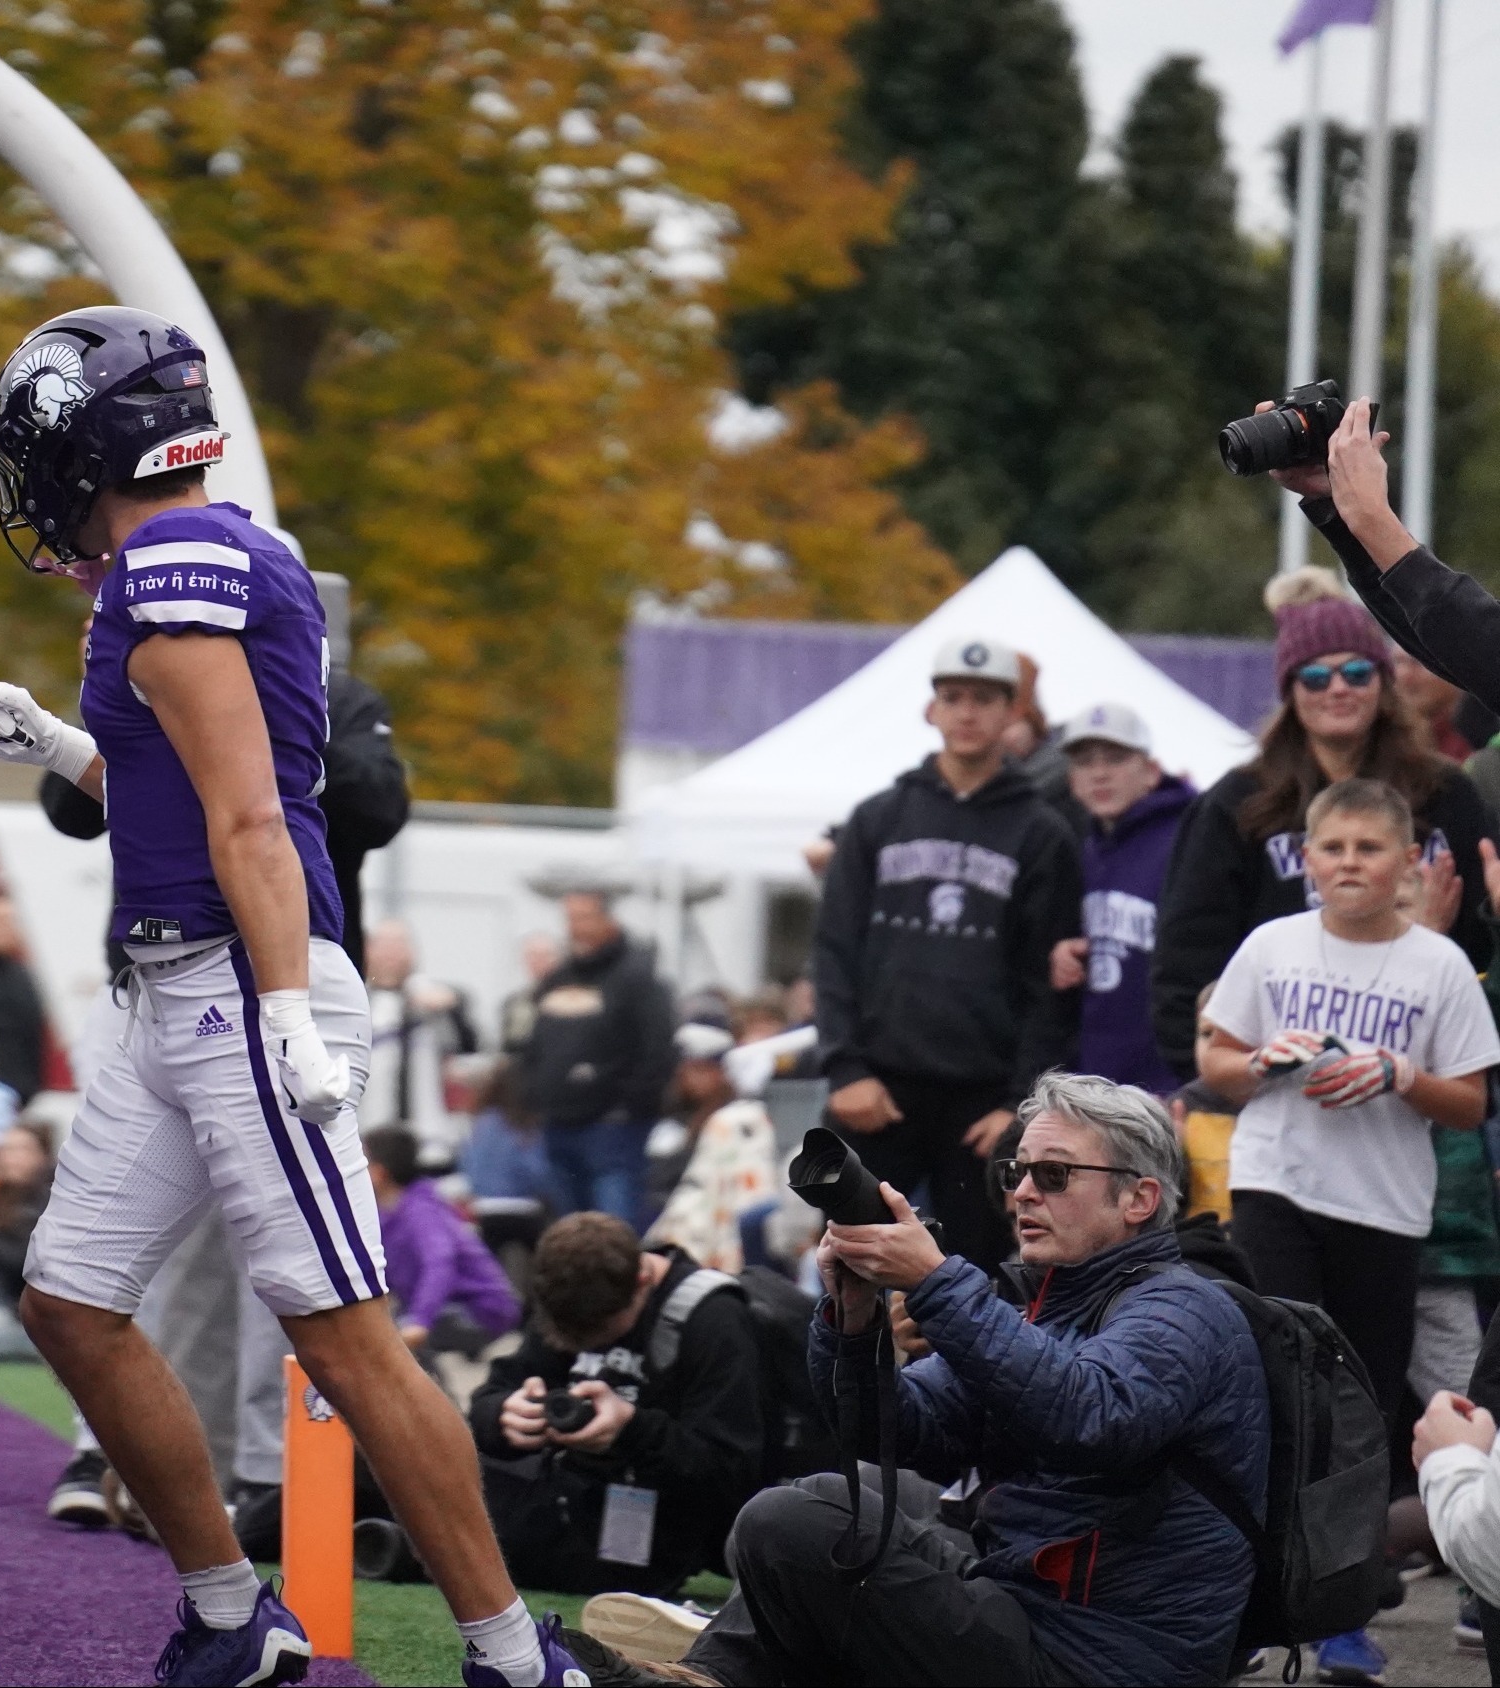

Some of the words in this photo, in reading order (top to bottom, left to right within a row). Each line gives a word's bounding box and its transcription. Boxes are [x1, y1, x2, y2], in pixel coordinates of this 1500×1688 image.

[166, 437, 225, 467] Riddel
[195, 1021, 234, 1037] adidas
[1265, 979, 1425, 1053] WARRIORS
